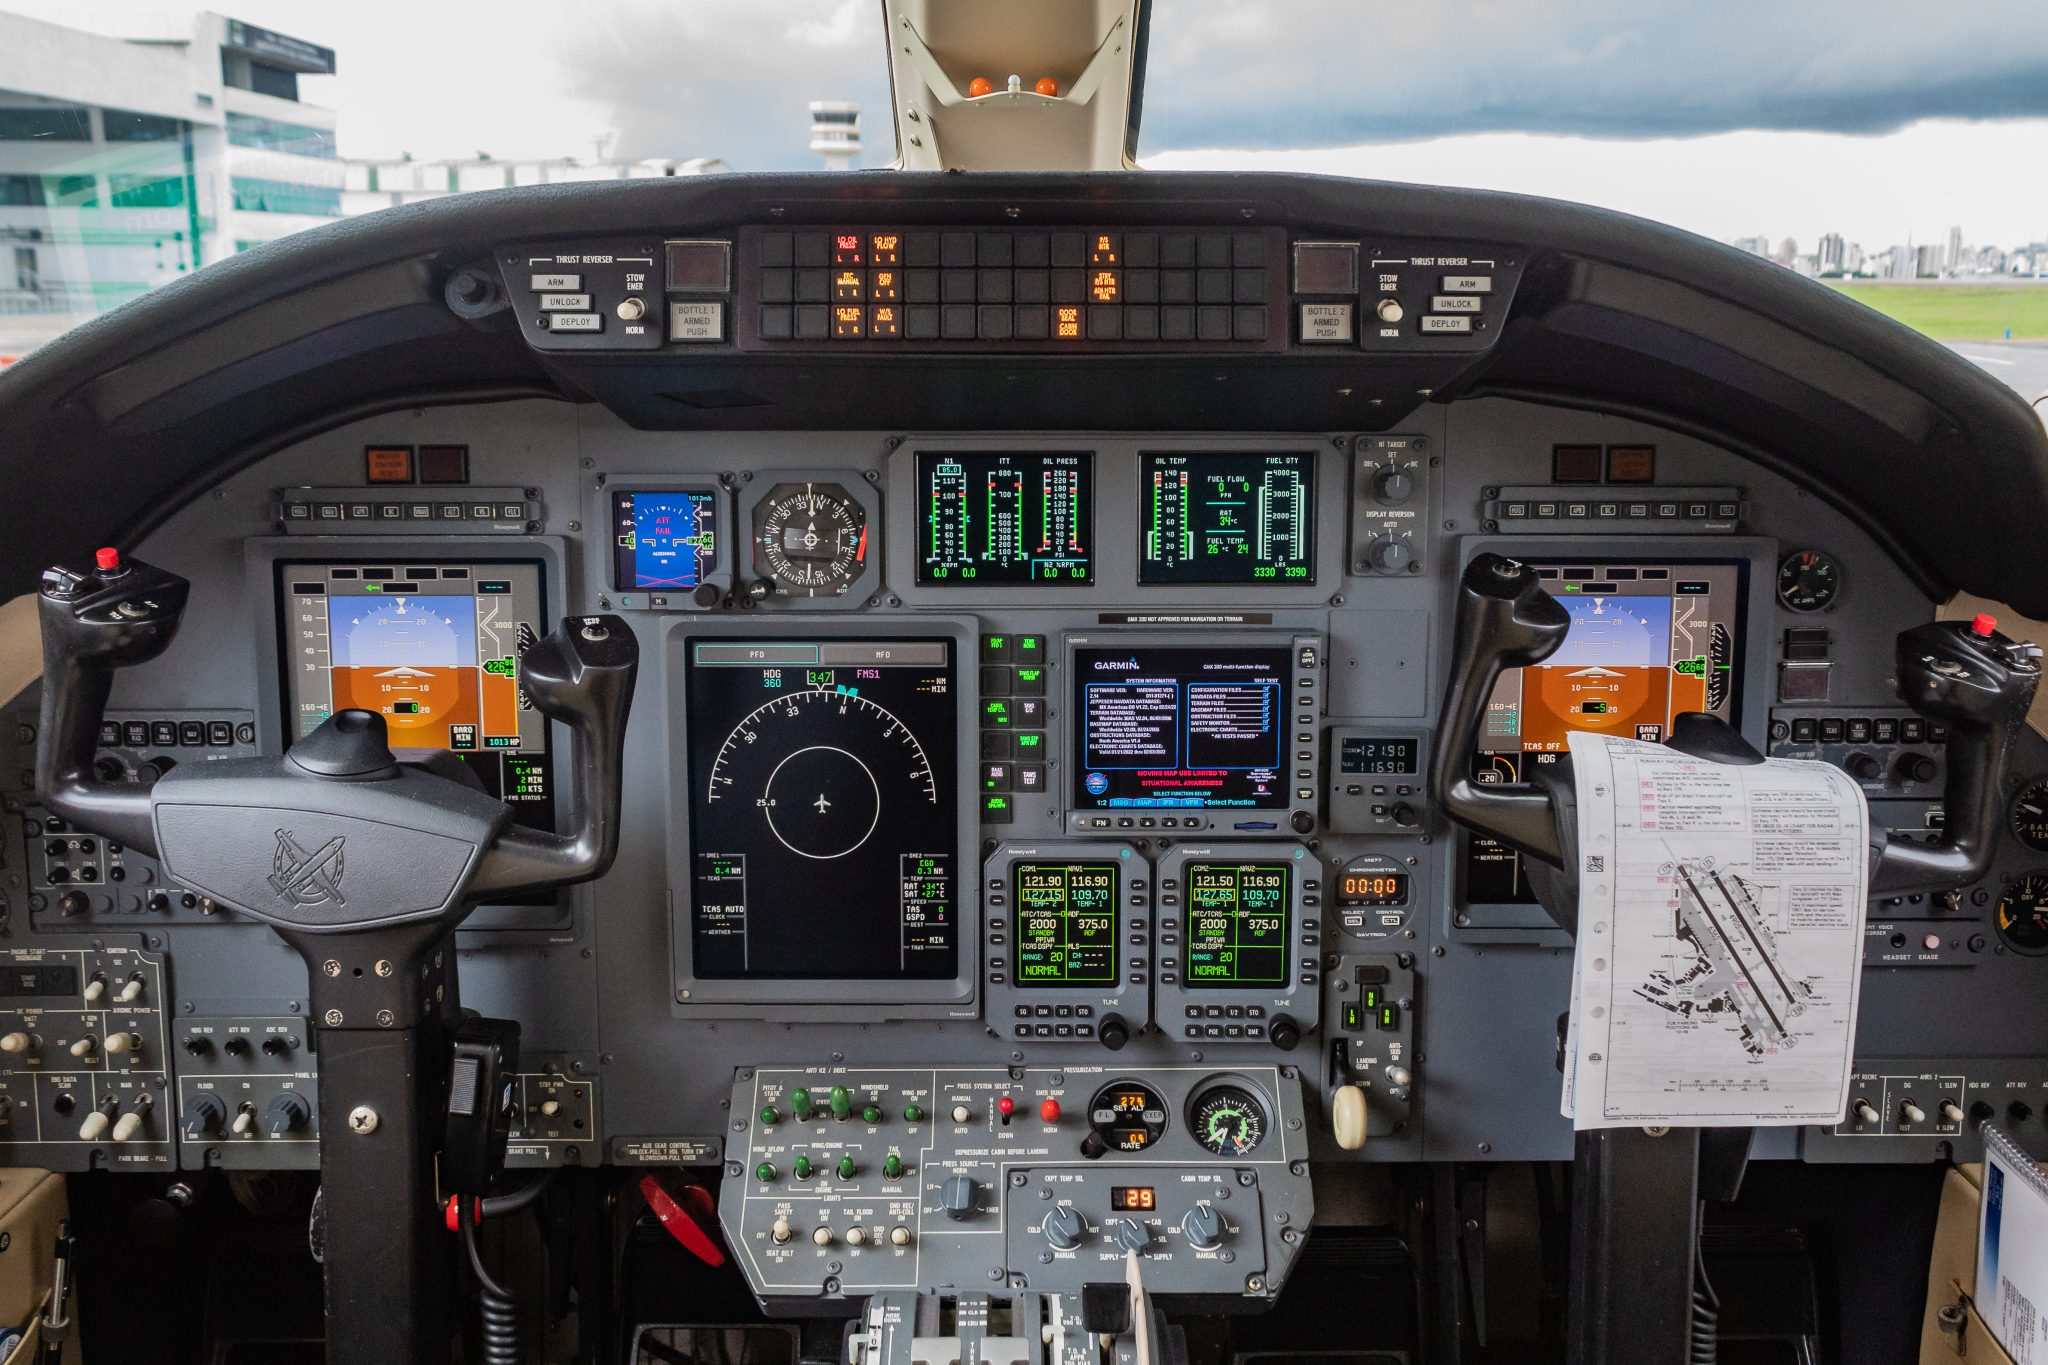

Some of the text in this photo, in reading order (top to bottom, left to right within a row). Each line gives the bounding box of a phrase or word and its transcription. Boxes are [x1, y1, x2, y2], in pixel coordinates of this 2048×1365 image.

[1411, 258, 1467, 266] THRUST REVERSER
[626, 274, 644, 282] STOW
[1380, 283, 1397, 291] EMER
[1460, 280, 1476, 288] ARM
[1441, 300, 1472, 308] UNLOCK
[1308, 307, 1345, 315] BOTTLE 2
[1313, 318, 1340, 326] ARMED
[1431, 320, 1460, 328] DEPLOY
[1380, 329, 1398, 337] NORM
[1208, 545, 1218, 554] 26
[1238, 545, 1248, 554] 24
[934, 568, 947, 577] 0.0
[963, 568, 976, 577] 0.0
[1044, 568, 1057, 577] 0.0
[1072, 568, 1085, 577] 0.0
[1255, 568, 1275, 576] 3330
[1286, 568, 1306, 576] 3390
[764, 670, 781, 679] HDG
[809, 672, 831, 682] 347
[857, 670, 880, 679] FMS1
[764, 679, 781, 687] 360
[1538, 755, 1556, 763] HDG
[1025, 876, 1061, 886] 121.90
[1071, 876, 1108, 886] 116.90
[1197, 876, 1233, 886] 121.50
[1243, 877, 1279, 886] 116.90
[1025, 890, 1061, 899] 127.15
[1071, 890, 1108, 899] 109.70
[1196, 890, 1233, 899] 127.65
[1243, 890, 1279, 900] 109.70
[1030, 920, 1056, 929] 2000
[1078, 920, 1107, 929] 375.0
[1249, 920, 1278, 929] 375.0
[1050, 952, 1063, 961] 20
[1026, 966, 1061, 975] NORMAL
[1195, 966, 1230, 975] NORMAL
[1128, 1191, 1151, 1206] 29
